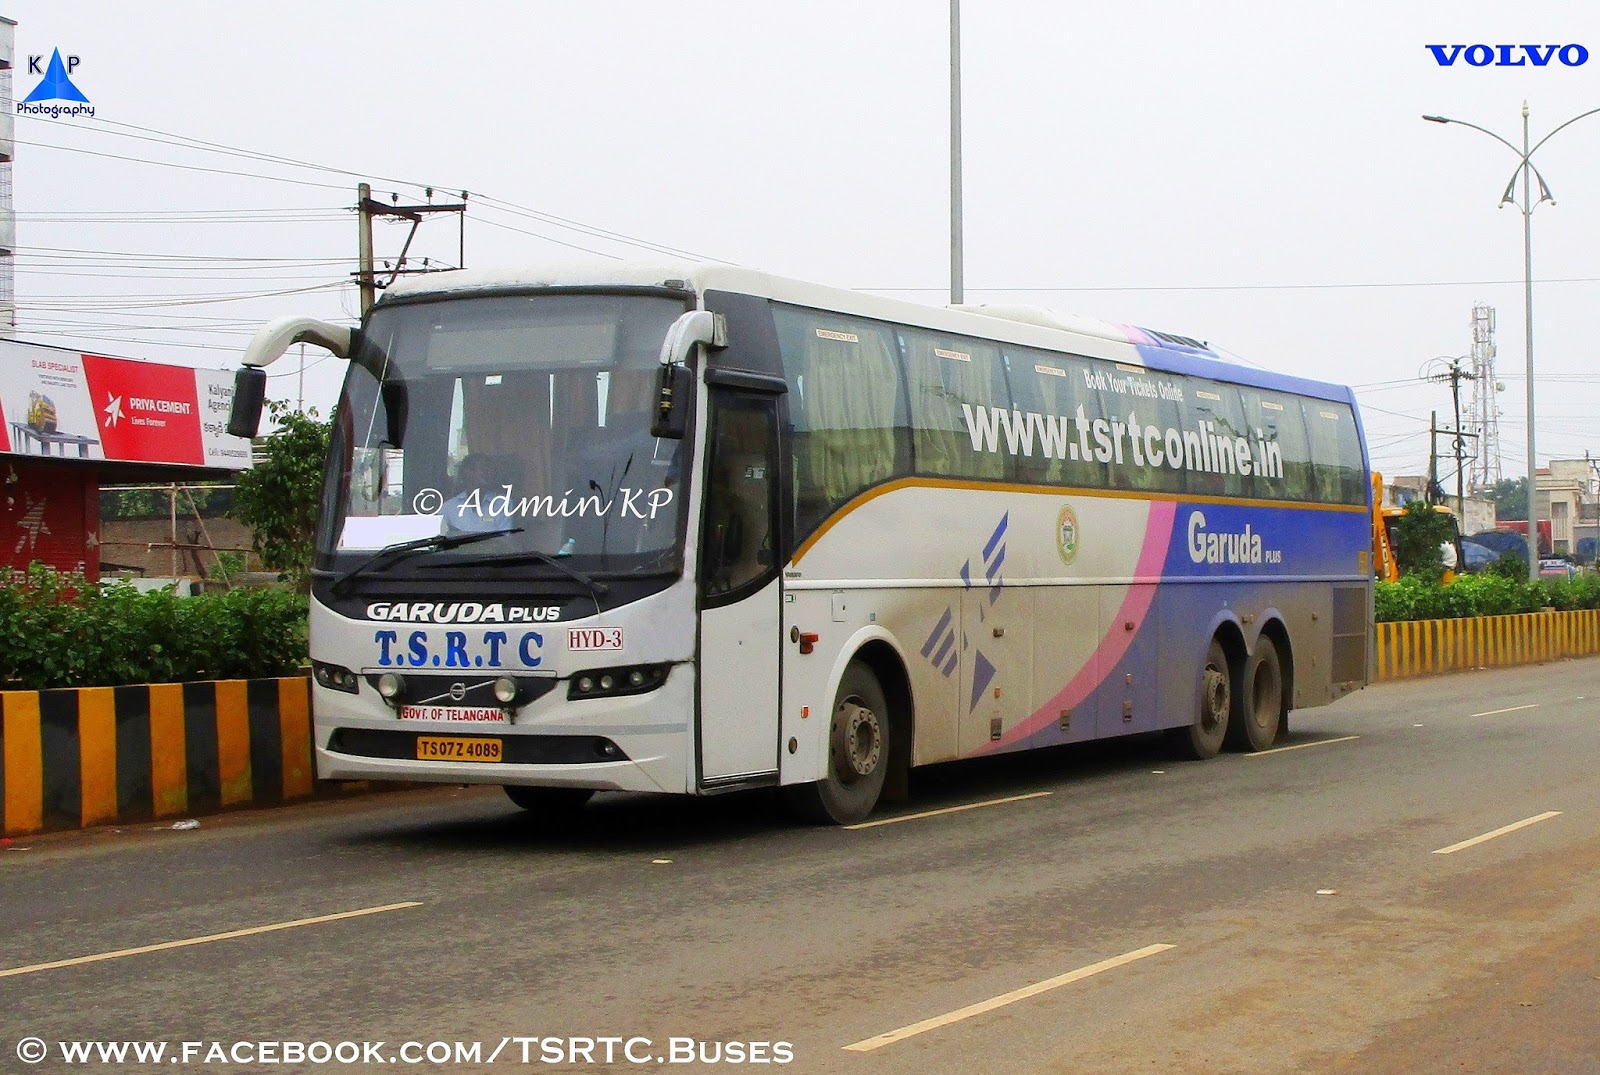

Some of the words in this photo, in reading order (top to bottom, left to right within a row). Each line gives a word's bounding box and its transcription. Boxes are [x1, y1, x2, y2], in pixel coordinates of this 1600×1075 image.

[1083, 368, 1107, 391] Book
[1105, 372, 1127, 395] Your
[1127, 376, 1158, 399] Tickets
[1158, 380, 1184, 402] Online
[129, 397, 156, 411] PRIYA
[156, 400, 191, 414] CEMENT
[961, 403, 1284, 478] www.tsrtconline.in
[1188, 510, 1262, 564] Garuda
[1265, 550, 1282, 564] PLUS
[366, 602, 504, 623] GARUDA
[508, 606, 561, 621] PLUS
[569, 629, 622, 649] HYD-3
[431, 708, 443, 720] OF
[446, 709, 504, 721] TELANGANA
